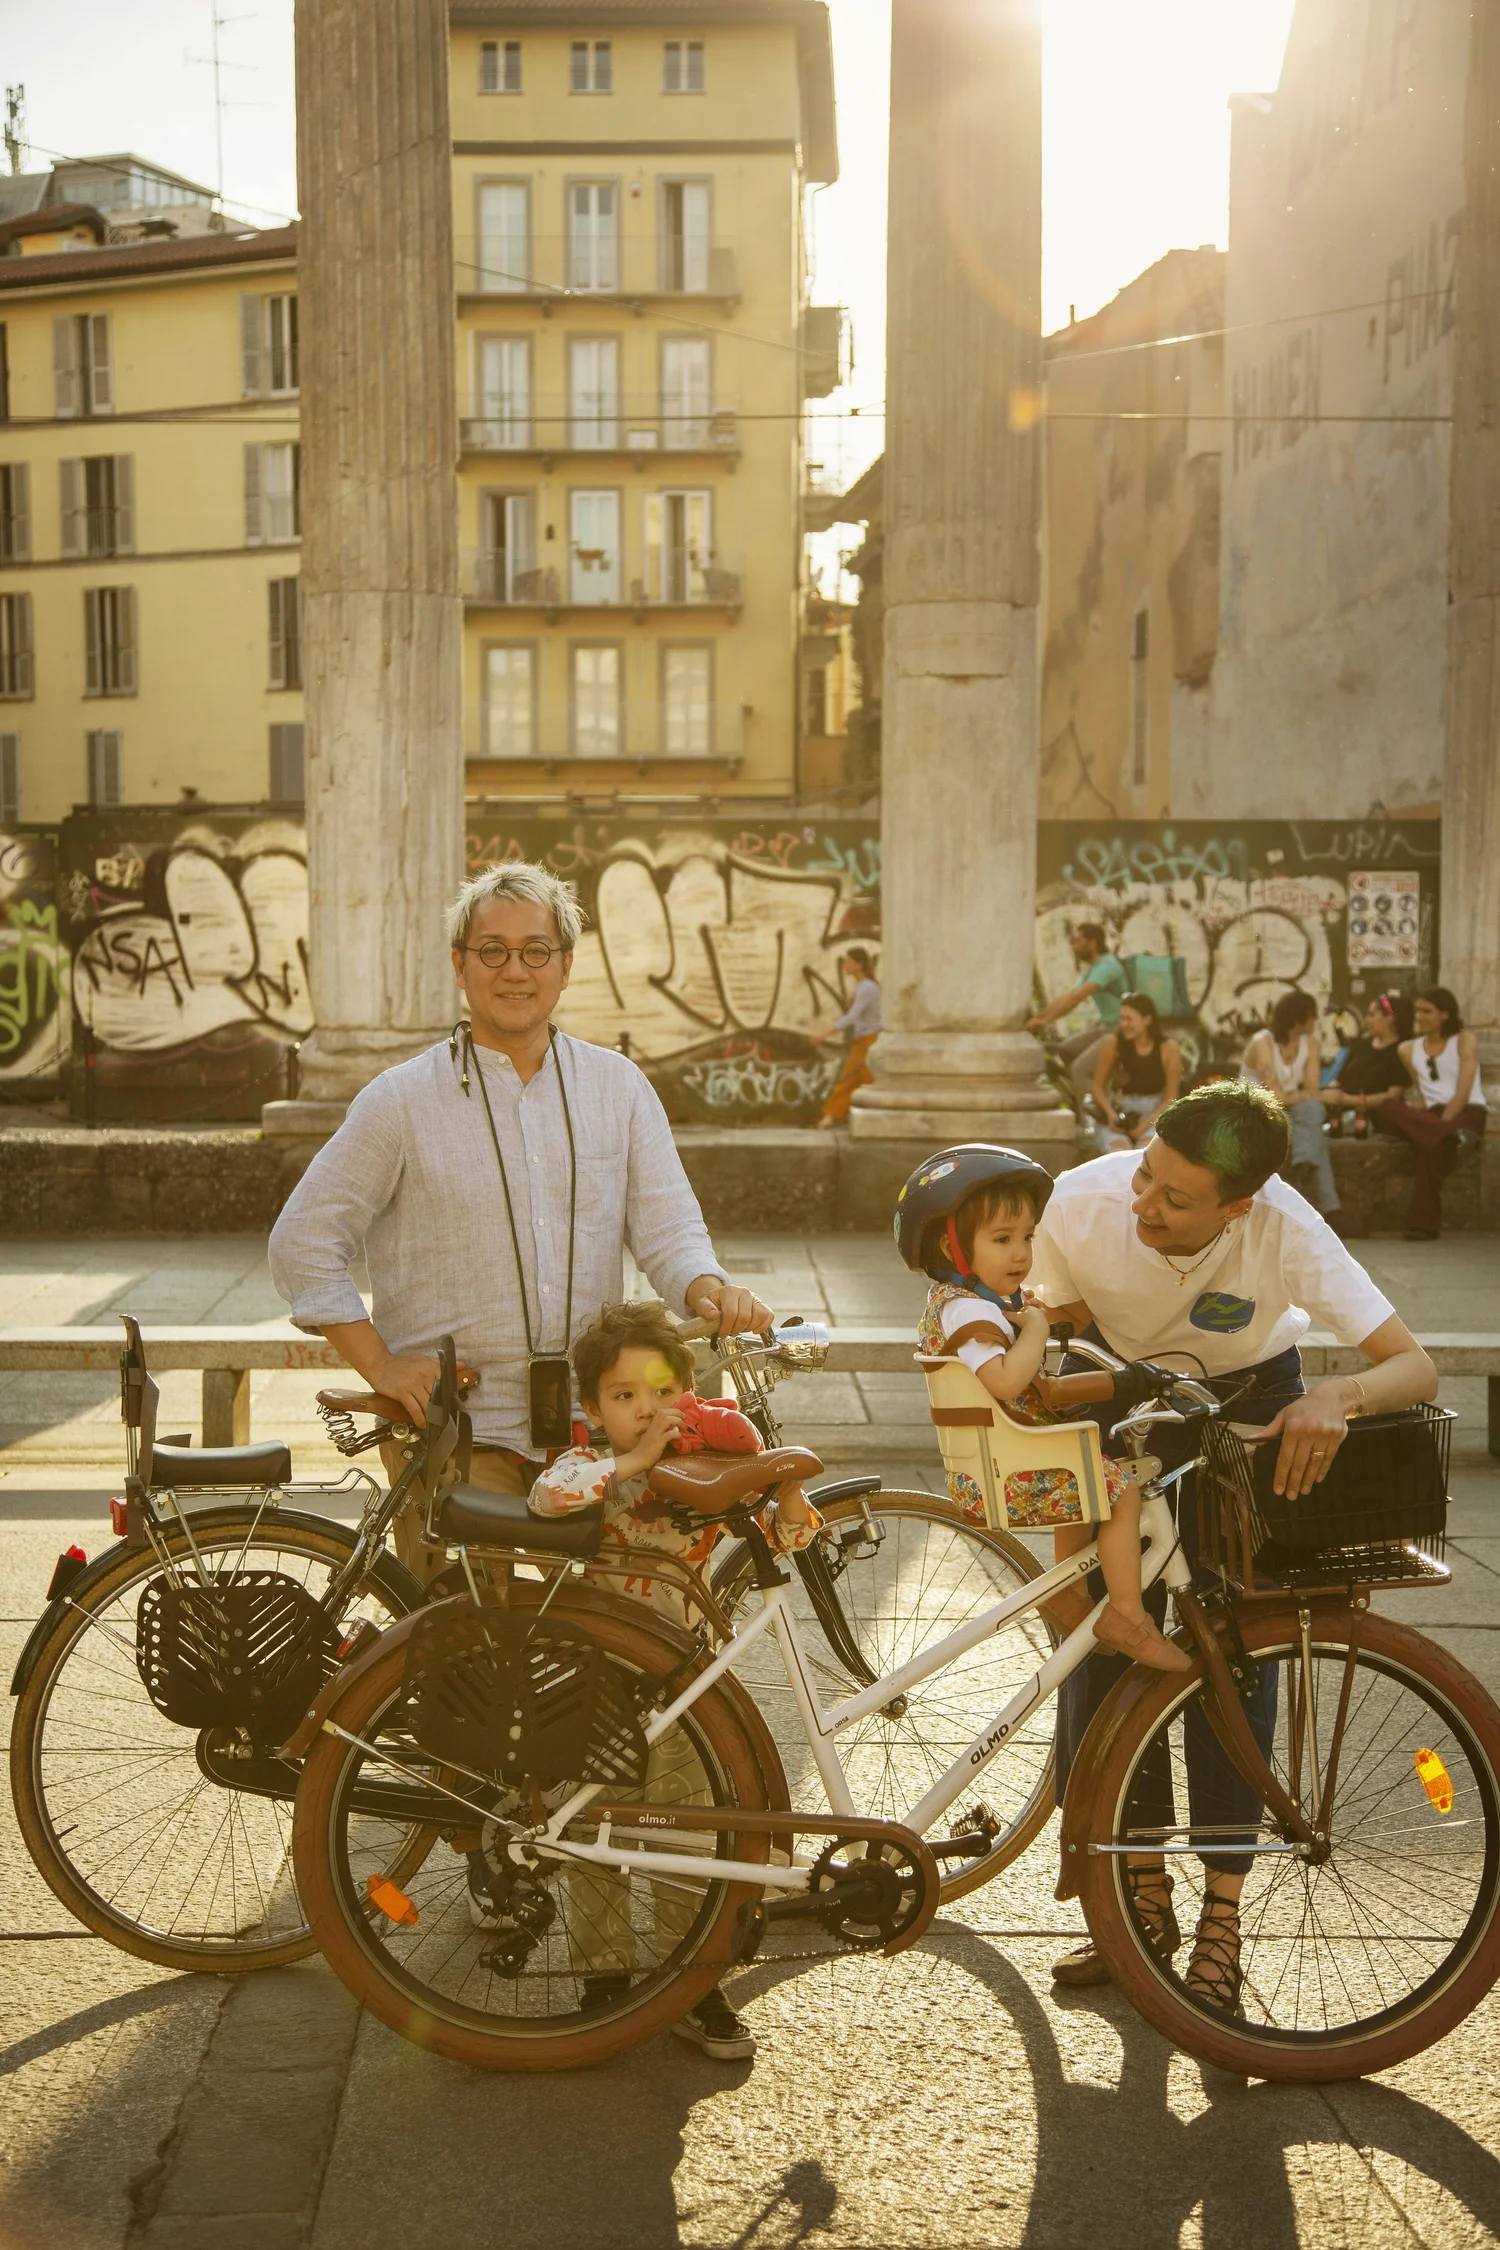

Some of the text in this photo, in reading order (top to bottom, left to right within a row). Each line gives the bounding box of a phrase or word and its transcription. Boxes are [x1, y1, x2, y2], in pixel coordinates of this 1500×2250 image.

[1077, 1552, 1100, 1573] DA
[970, 1723, 1010, 1765] OLMO
[638, 1812, 677, 1825] olmo.it
